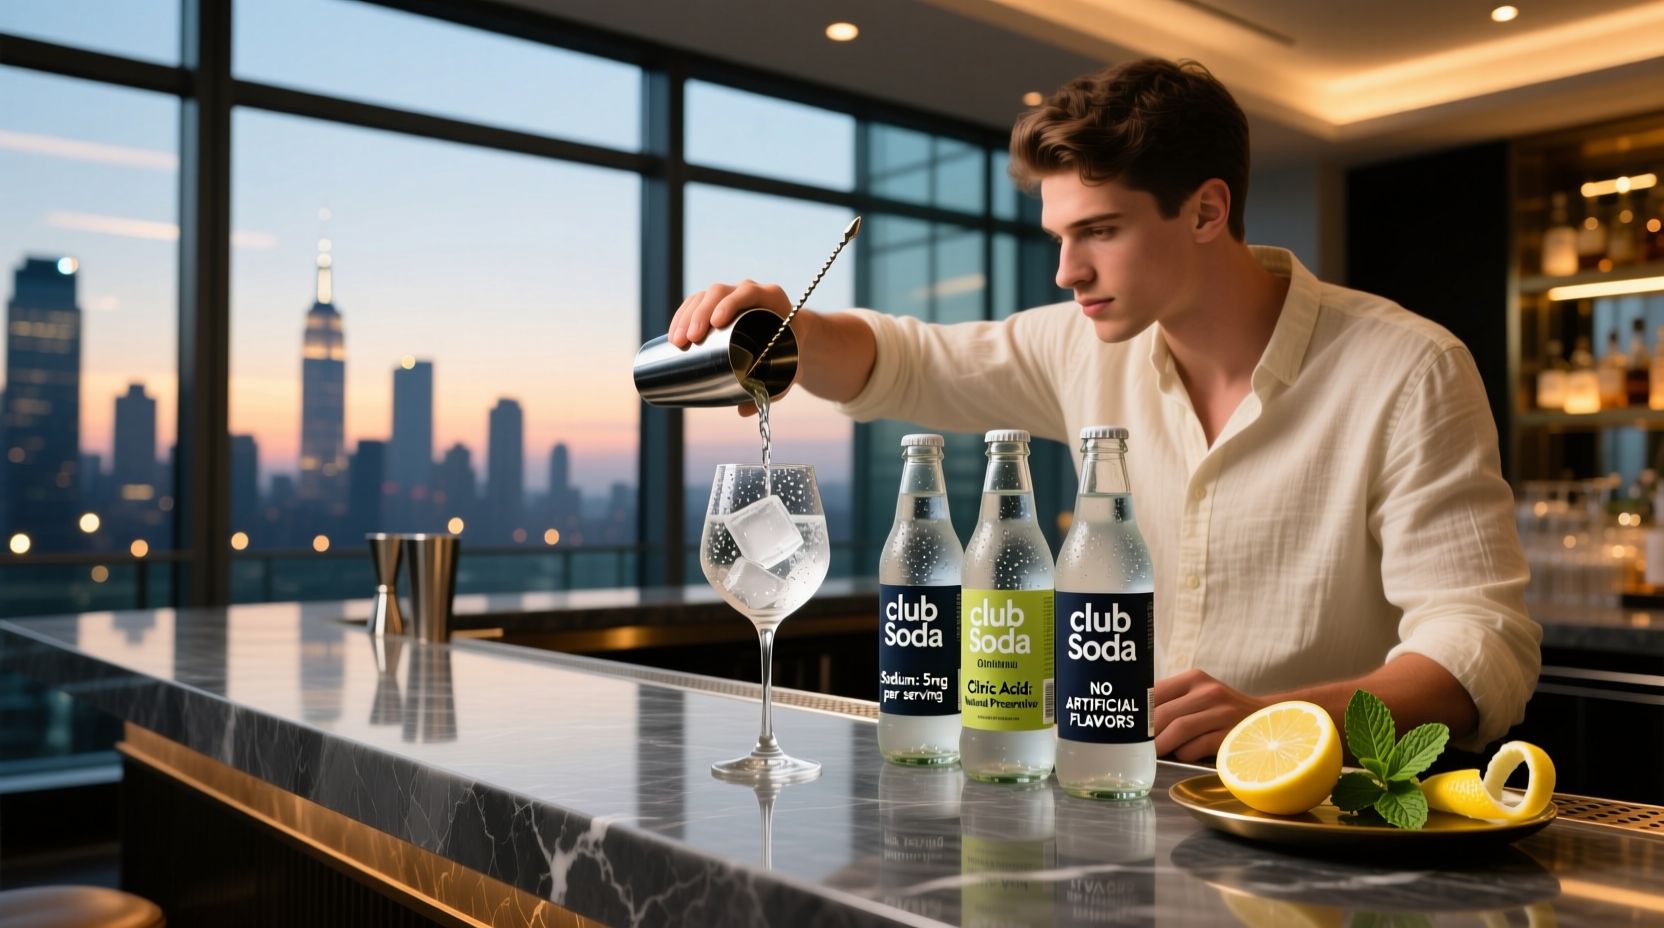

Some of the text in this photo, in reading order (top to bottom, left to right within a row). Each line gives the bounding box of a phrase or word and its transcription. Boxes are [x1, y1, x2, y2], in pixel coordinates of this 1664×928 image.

[886, 594, 938, 621] club
[969, 598, 1024, 627] club
[1070, 602, 1132, 633] club
[884, 622, 943, 647] Soda
[969, 627, 1031, 654] Soda
[1068, 633, 1137, 661] Soda
[884, 689, 900, 703] per
[1090, 681, 1113, 696] NO
[1065, 696, 1139, 712] ARTIFICIAL
[1070, 712, 1135, 728] FLAVORS
